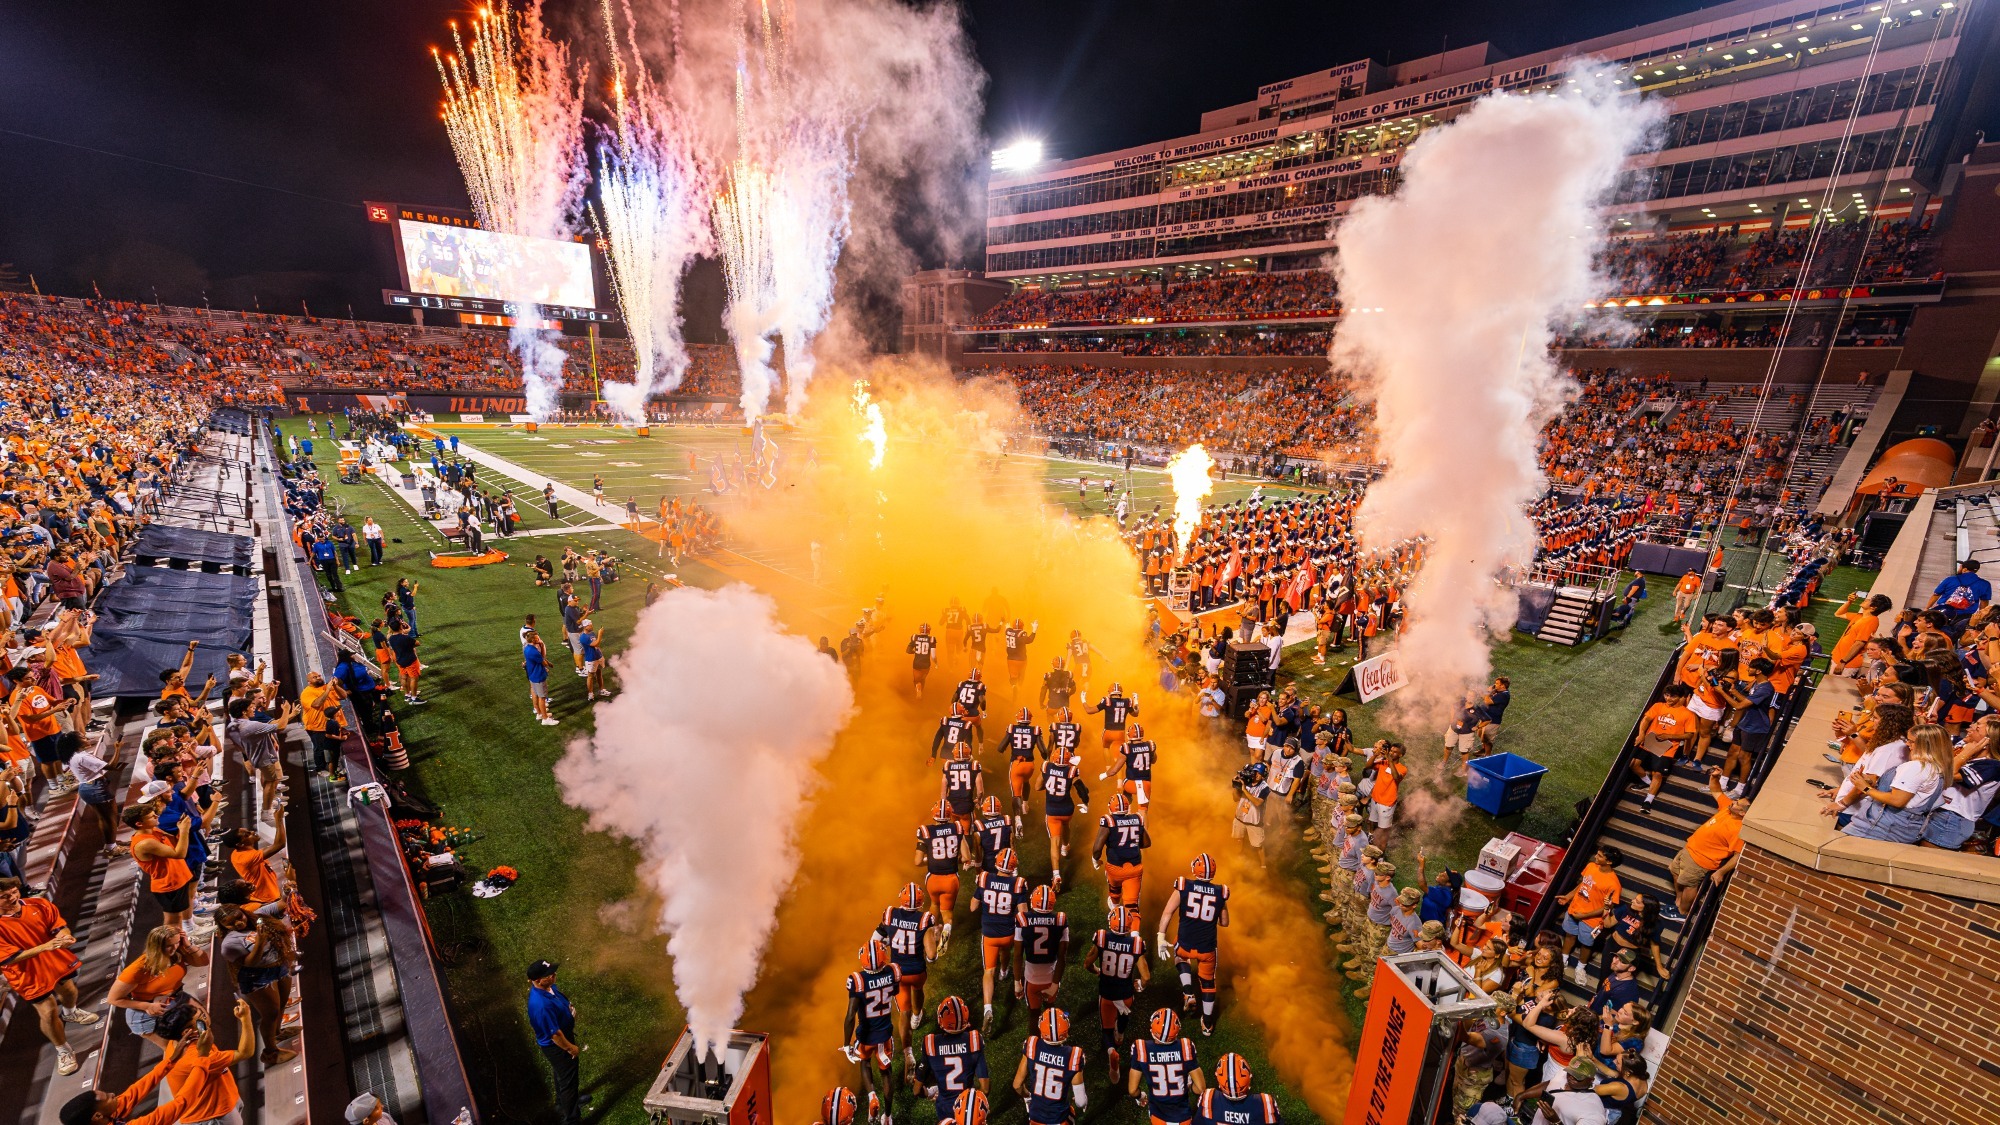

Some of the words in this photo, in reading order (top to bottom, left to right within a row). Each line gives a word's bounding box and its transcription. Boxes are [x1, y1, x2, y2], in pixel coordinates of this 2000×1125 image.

[1330, 61, 1367, 78] BUTKUS
[1261, 81, 1293, 95] GRANGE
[1341, 75, 1352, 87] 50
[1271, 94, 1280, 105] 77
[1332, 107, 1368, 124] HOME
[1372, 102, 1389, 114] OF
[1394, 95, 1420, 110] THE
[1424, 77, 1494, 103] FIGHTING
[1498, 65, 1548, 86] ILLINI
[1114, 154, 1156, 168] WELCOME
[1159, 150, 1171, 159] TO
[1174, 138, 1226, 156] MEMORIAL
[1230, 128, 1278, 146] STADIUM
[1379, 154, 1397, 165] 1927
[1238, 173, 1290, 190] NATIONAL
[1294, 161, 1362, 180] CHAMPIONS
[372, 208, 387, 220] 25
[402, 210, 481, 228] MEMORIA
[1271, 203, 1336, 220] CHAMPIONS
[432, 244, 453, 261] 56
[421, 297, 428, 307] 0
[974, 630, 981, 642] 5
[915, 642, 930, 655] 30
[960, 688, 976, 704] 45
[1114, 707, 1126, 723] 11
[947, 727, 959, 744] 8
[1013, 733, 1032, 750] 33
[1056, 730, 1076, 747] 32
[1133, 753, 1151, 771] 41
[949, 770, 971, 790] 39
[1045, 776, 1067, 796] 43
[990, 827, 1002, 851] 7
[1118, 826, 1140, 848] 75
[931, 835, 959, 860] 88
[990, 881, 1010, 891] PINTON
[983, 889, 1012, 915] 98
[1186, 891, 1217, 922] 56
[899, 919, 919, 931] KRENTZ
[1028, 917, 1055, 926] KARRIEM
[891, 928, 917, 955] 41
[1033, 926, 1049, 955] 2
[1107, 940, 1131, 953] BEATTY
[1102, 950, 1135, 979] 80
[868, 975, 893, 989] CLARKE
[865, 985, 894, 1019] 25
[1381, 995, 1406, 1070] ORANGE
[938, 1042, 967, 1056] HOLLINS
[1149, 1052, 1156, 1063] G.
[1157, 1051, 1182, 1063] GRIFFIN
[1038, 1051, 1065, 1067] HECKEL
[943, 1056, 965, 1091] 2
[1033, 1063, 1065, 1101] 16
[1148, 1063, 1186, 1097] 35
[1375, 1059, 1393, 1094] THE
[1370, 1088, 1386, 1119] TO
[1224, 1110, 1250, 1125] GESKY
